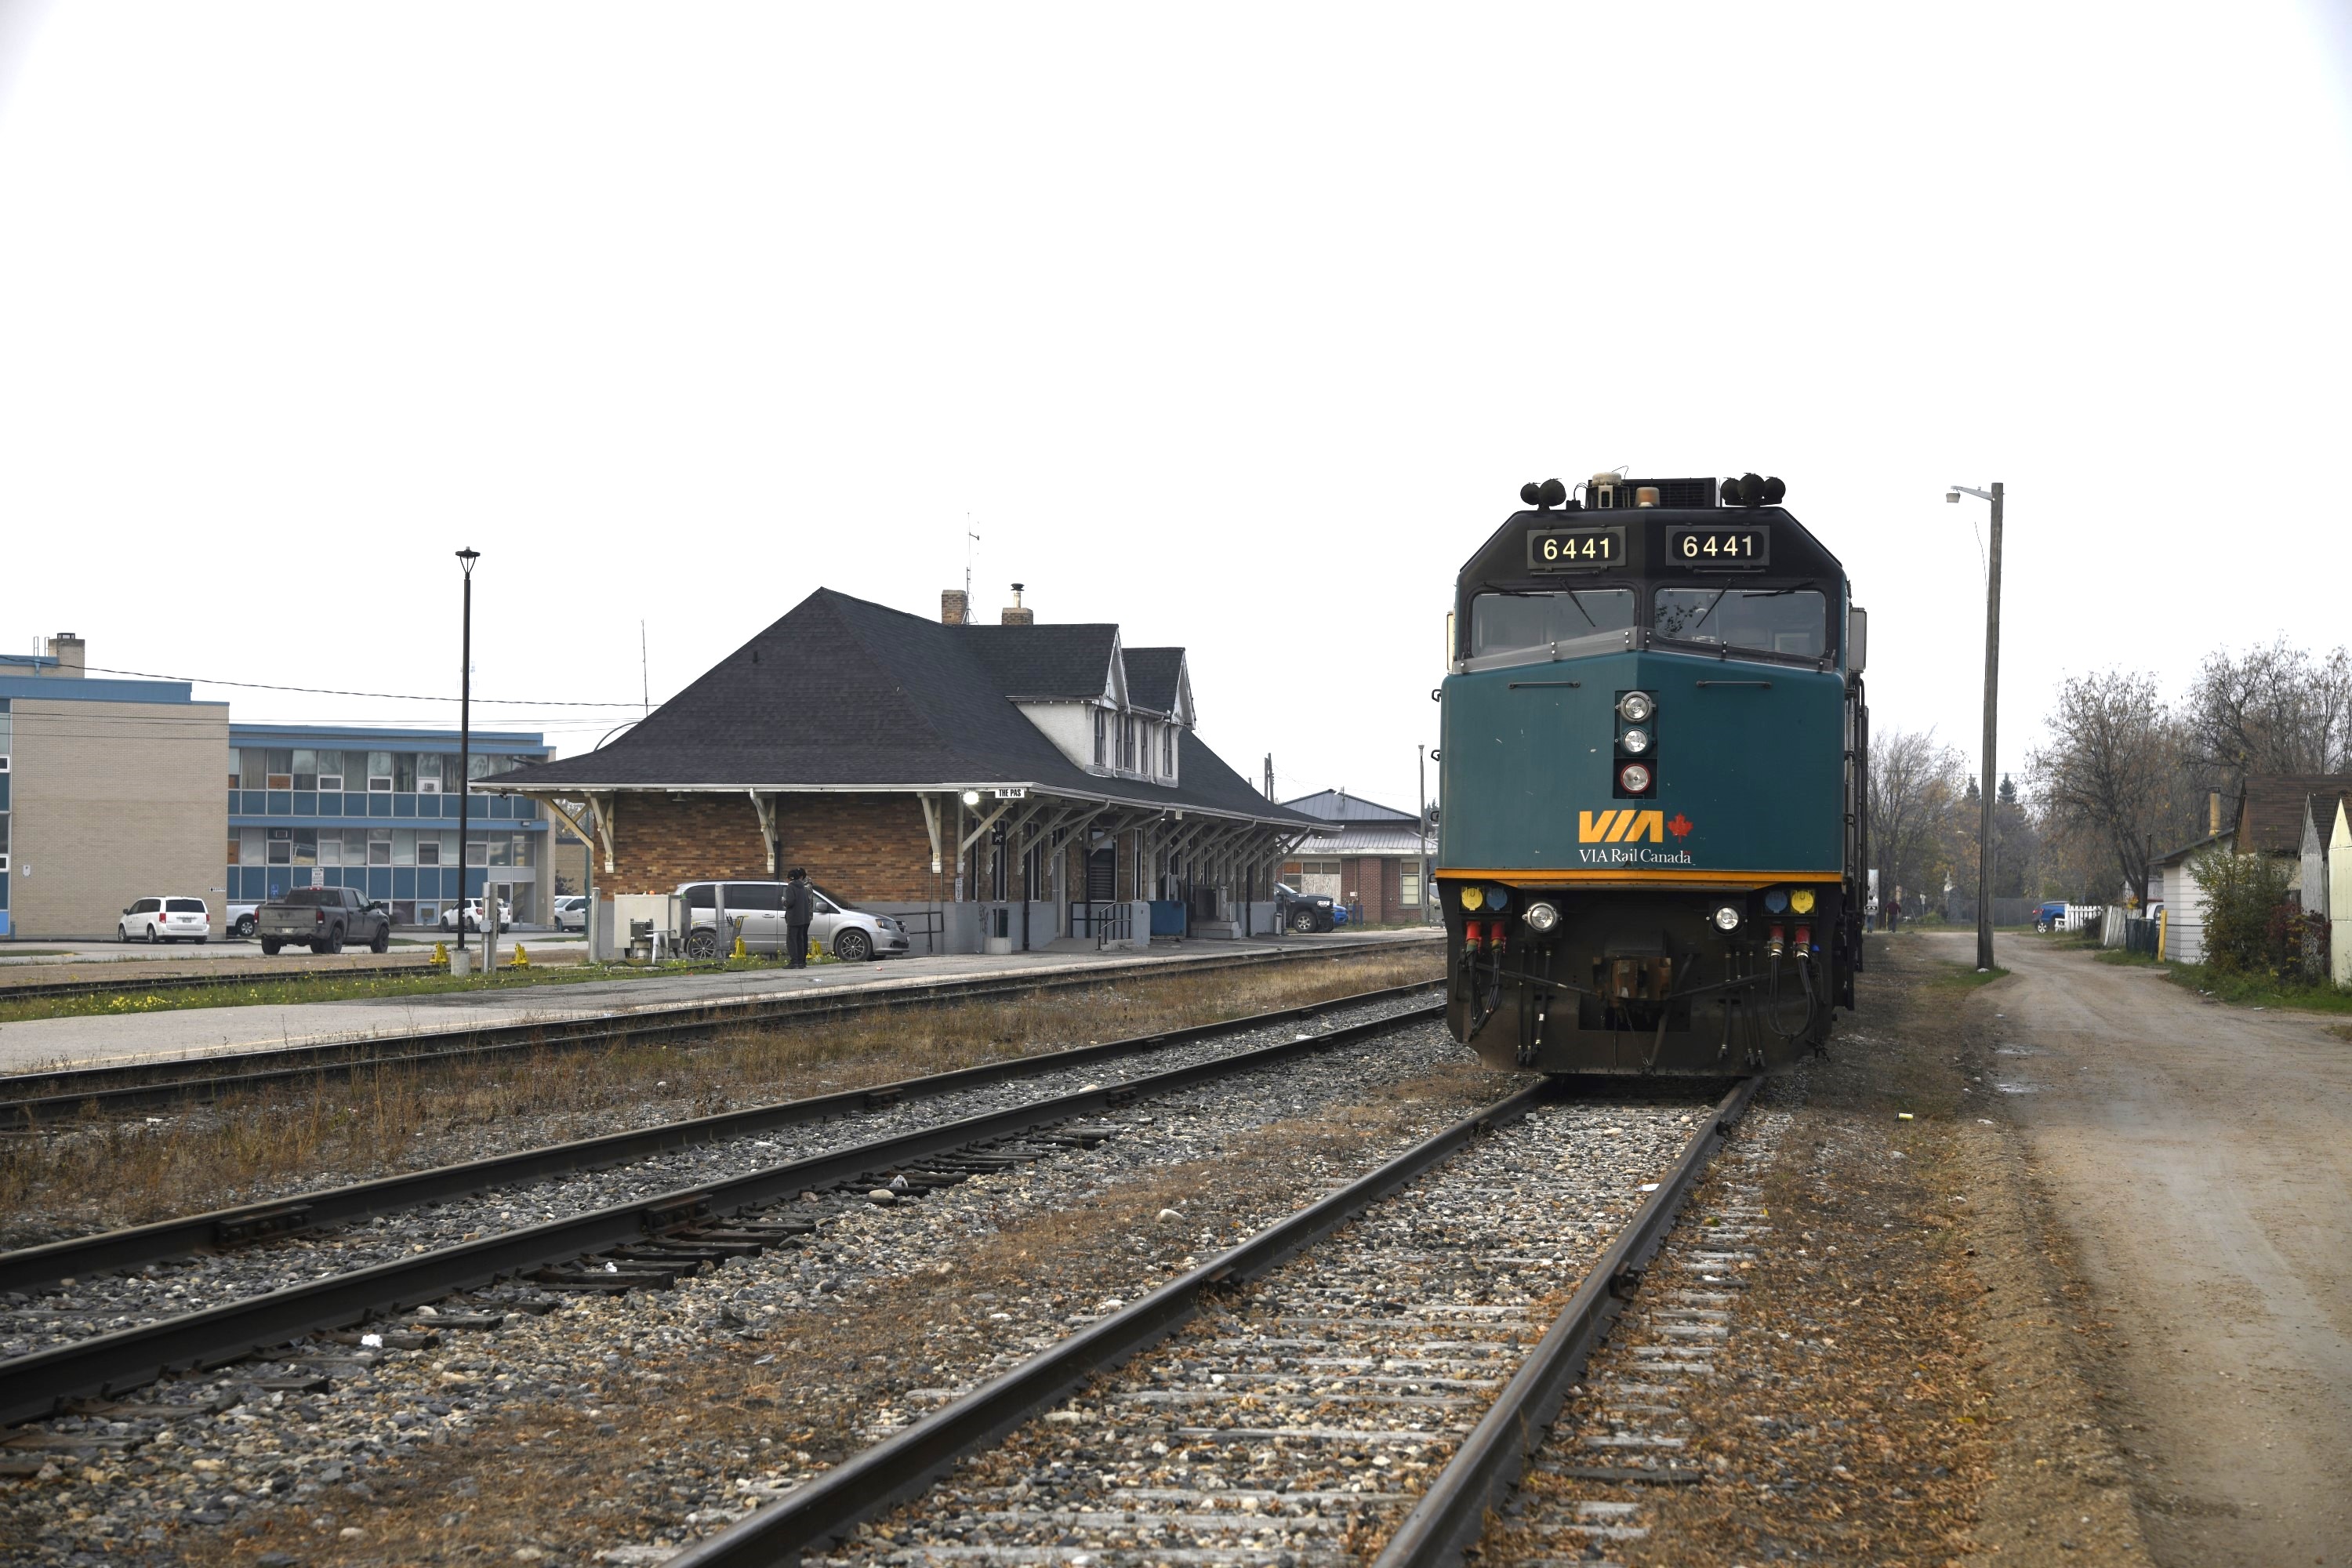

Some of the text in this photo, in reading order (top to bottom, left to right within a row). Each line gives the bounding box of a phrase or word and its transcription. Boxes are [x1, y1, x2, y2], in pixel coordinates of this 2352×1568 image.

[1544, 538, 1609, 560] 6441
[1683, 535, 1751, 557] 6441
[1579, 810, 1664, 843] VIA
[1579, 848, 1691, 864] VIA Rail Canada
